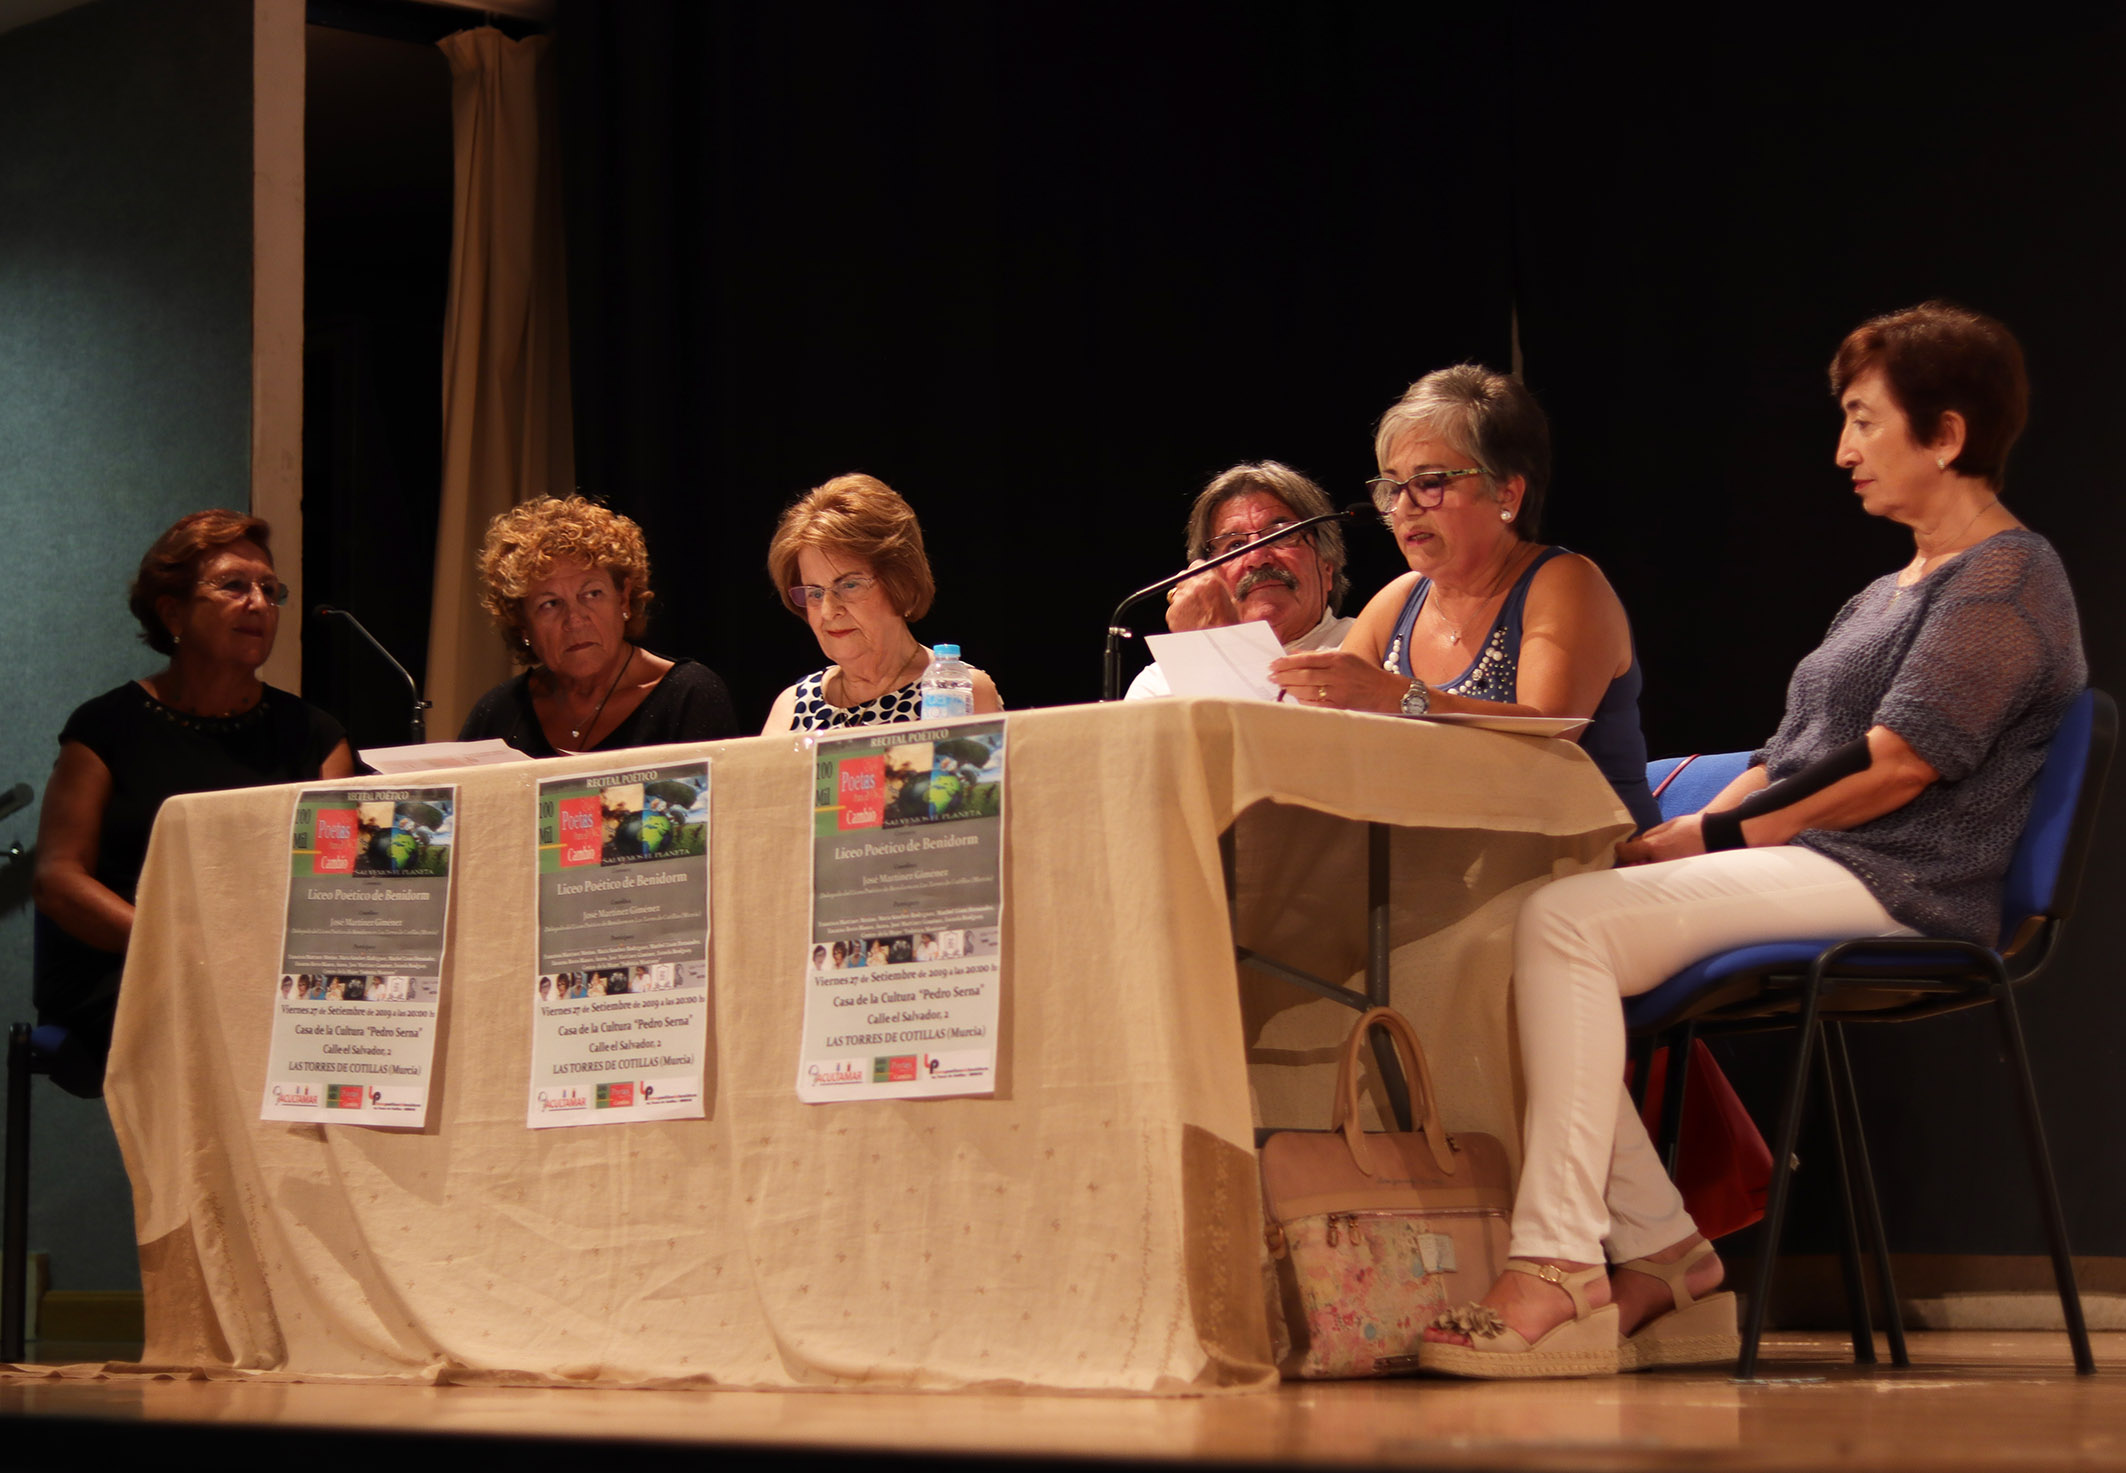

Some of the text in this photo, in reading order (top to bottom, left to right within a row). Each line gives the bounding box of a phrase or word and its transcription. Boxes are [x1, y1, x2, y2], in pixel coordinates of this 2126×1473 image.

[871, 728, 949, 747] RECITAL POÉTICO
[586, 770, 658, 787] RECITAL POÉTICO
[816, 761, 832, 780] 100
[842, 772, 875, 792] Poetas
[816, 788, 830, 806] Mil
[540, 801, 554, 818] 100
[846, 808, 876, 825] Cambio
[562, 811, 593, 830] Poetas
[318, 820, 350, 839] Poetas
[568, 846, 595, 862] Cambio
[835, 834, 978, 860] Liceo Poético de Benidorm
[321, 855, 348, 870] Cambio
[557, 884, 583, 895] Liceo
[585, 879, 621, 892] Poético
[623, 877, 634, 888] de
[637, 872, 687, 887] Benidorm
[308, 889, 430, 901] Liceo Poético de Benidorm
[815, 976, 848, 986] Viernes
[849, 976, 859, 986] 27
[860, 974, 869, 983] de
[871, 969, 916, 983] Setiembre
[919, 969, 927, 978] de
[929, 968, 948, 979] 2019
[954, 966, 964, 975] las
[833, 996, 854, 1007] Casa
[857, 993, 868, 1005] de
[870, 993, 878, 1004] la
[881, 990, 916, 1003] Cultura
[281, 1004, 309, 1015] Viernes
[310, 1007, 318, 1016] 27
[328, 1006, 365, 1016] Setiembre
[541, 1007, 571, 1016] Viernes
[572, 1007, 581, 1016] 27
[592, 1000, 632, 1013] Setiembre
[642, 999, 659, 1010] 2019
[867, 1013, 890, 1024] Calle
[892, 1012, 900, 1022] el
[902, 1009, 942, 1022] Salvador,
[295, 1025, 313, 1034] Casa
[315, 1024, 325, 1035] de
[326, 1025, 333, 1035] la
[335, 1025, 364, 1036] Cultura
[559, 1026, 577, 1036] Casa
[579, 1023, 589, 1034] de
[591, 1023, 598, 1033] la
[601, 1020, 632, 1032] Cultura
[826, 1025, 986, 1047] LAS TORRES DE COTILLAS (Murcia)
[323, 1044, 342, 1054] Calle
[343, 1044, 350, 1054] el
[352, 1045, 386, 1056] Salvador,
[589, 1043, 609, 1053] Calle
[611, 1041, 618, 1051] el
[620, 1039, 656, 1051] Salvador,
[289, 1061, 422, 1076] LAS TORRES DE COTILLAS (Murcia)
[553, 1054, 694, 1074] LAS TORRES DE COTILLAS (Murcia)
